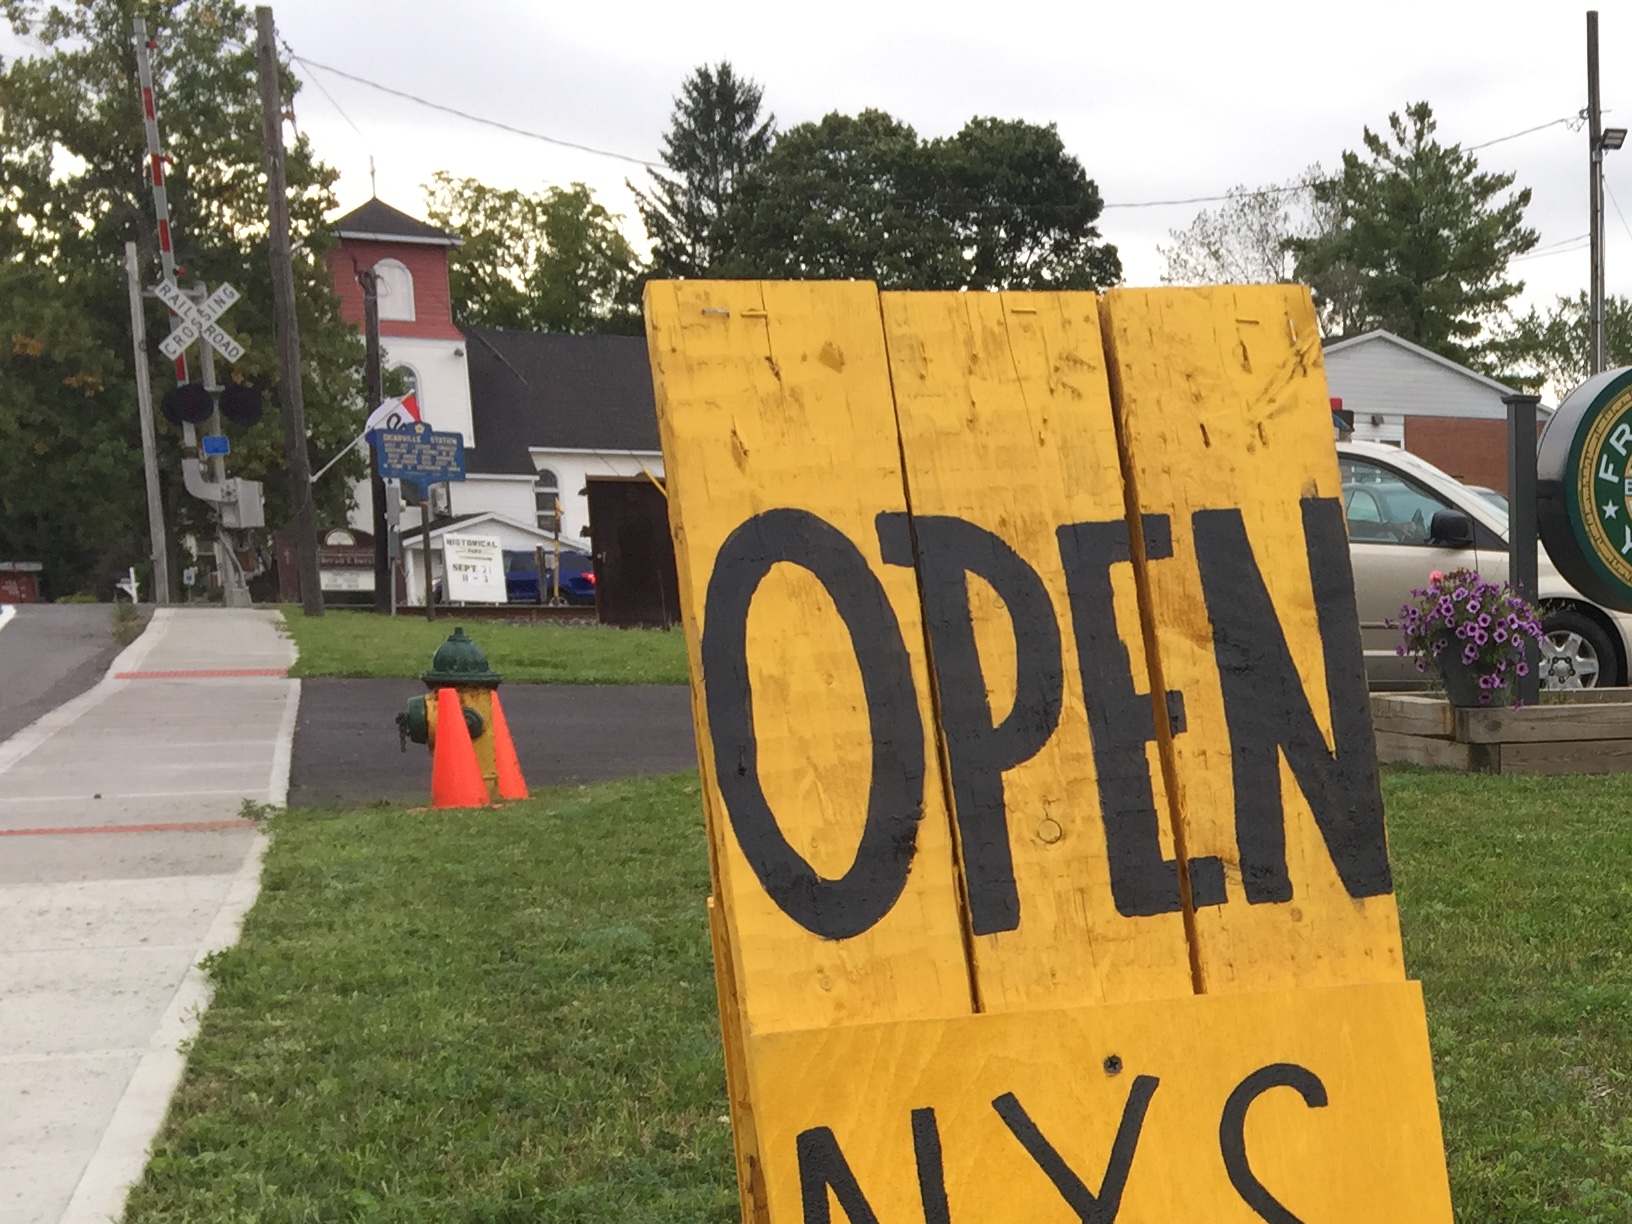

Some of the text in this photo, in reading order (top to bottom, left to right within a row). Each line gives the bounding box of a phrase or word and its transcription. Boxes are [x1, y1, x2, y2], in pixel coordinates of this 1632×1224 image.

[159, 283, 240, 358] RAILROAD
[164, 286, 236, 356] CROSSING
[446, 538, 498, 548] HISTORICAL
[701, 496, 1394, 940] OPEN
